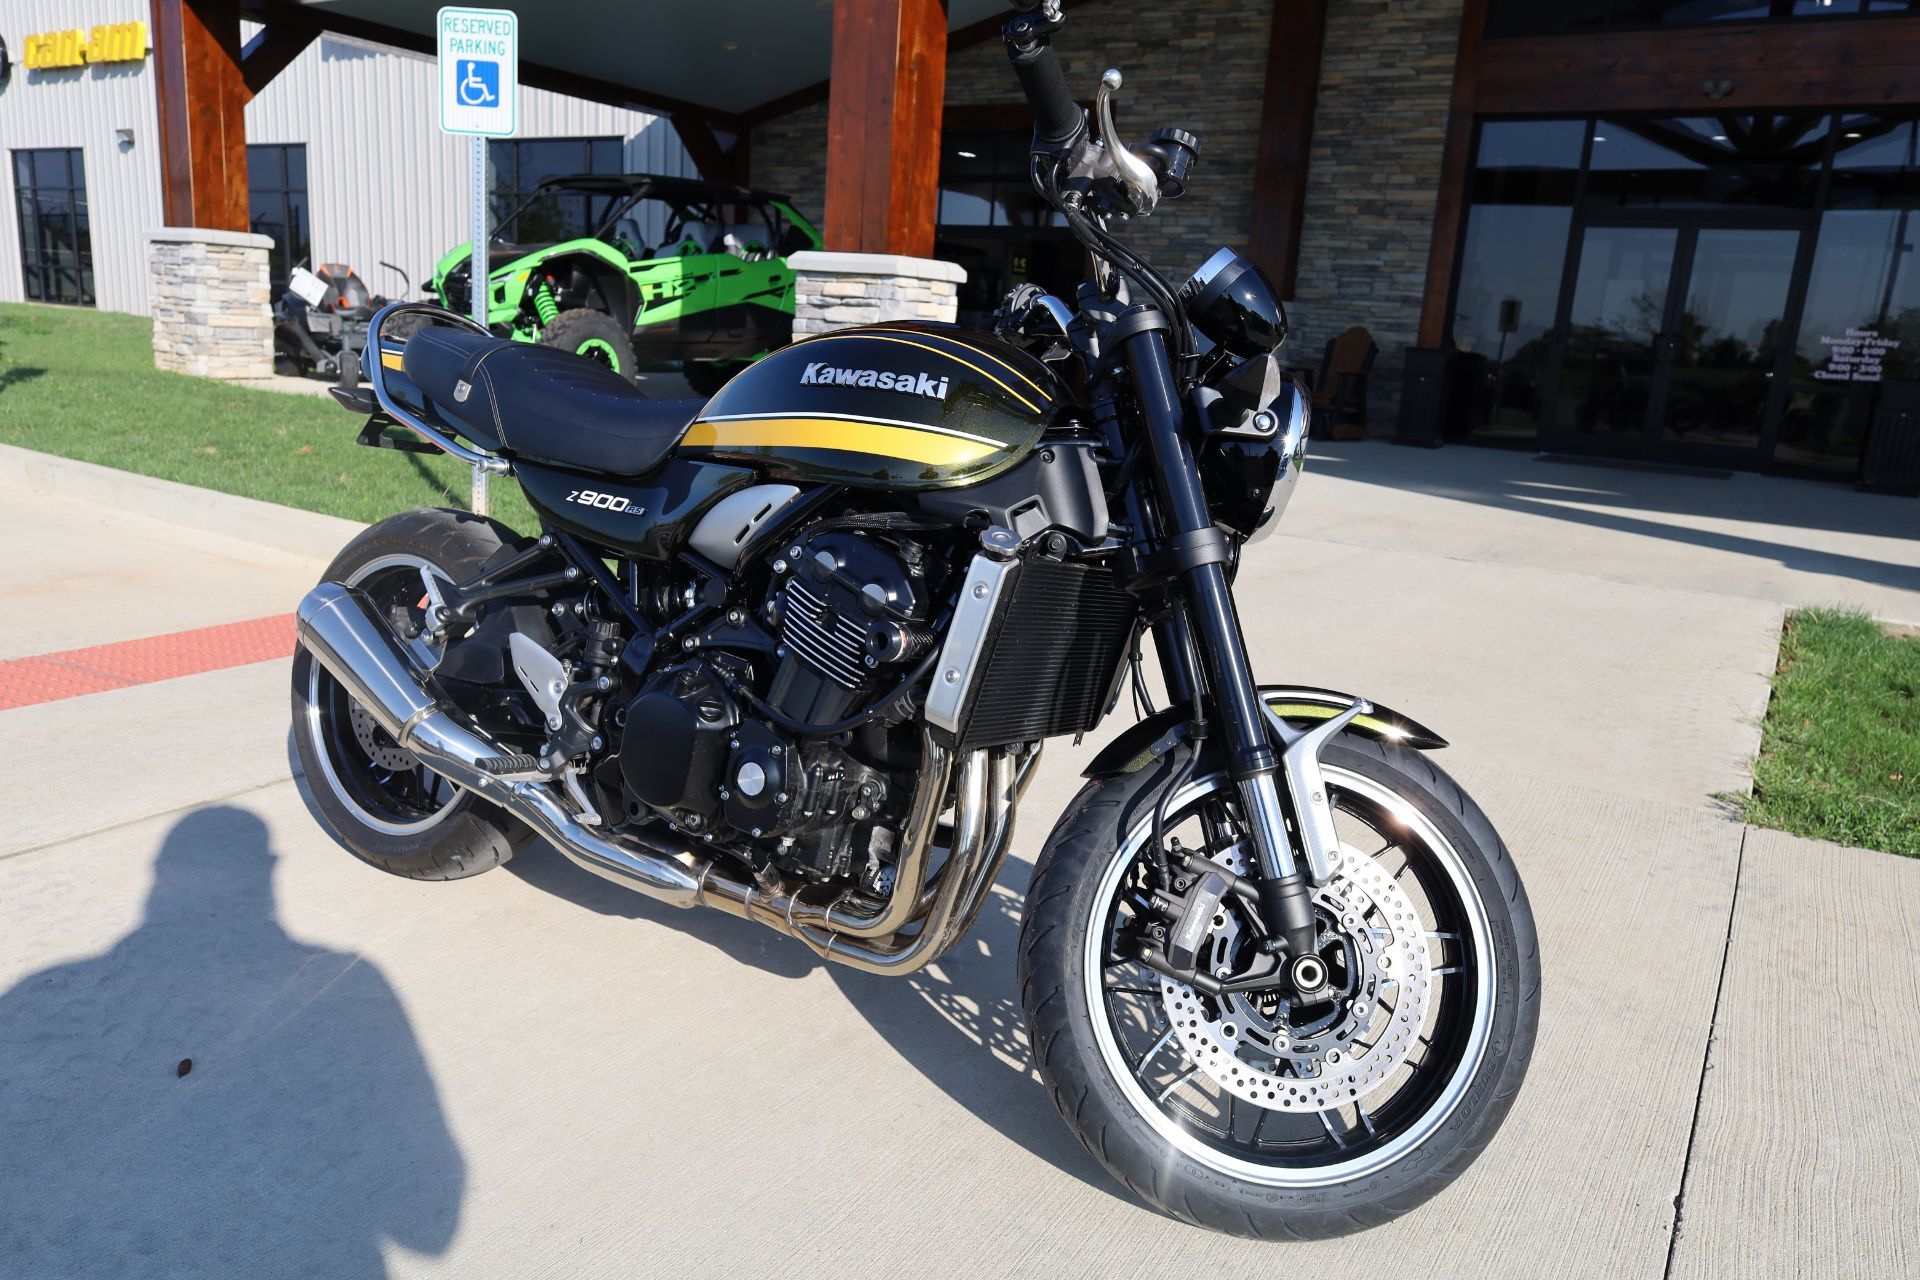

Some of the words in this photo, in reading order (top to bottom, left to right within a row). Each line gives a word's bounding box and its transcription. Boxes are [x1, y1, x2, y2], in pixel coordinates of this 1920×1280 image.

[444, 17, 511, 36] RESERVED
[449, 38, 506, 56] PARKING
[1845, 328, 1878, 337] Hours
[1821, 336, 1900, 348] Monday-Friday
[1832, 354, 1881, 365] Saturday
[800, 362, 949, 400] Kawasaki
[1814, 370, 1850, 380] Closed
[1852, 372, 1881, 381] Sund
